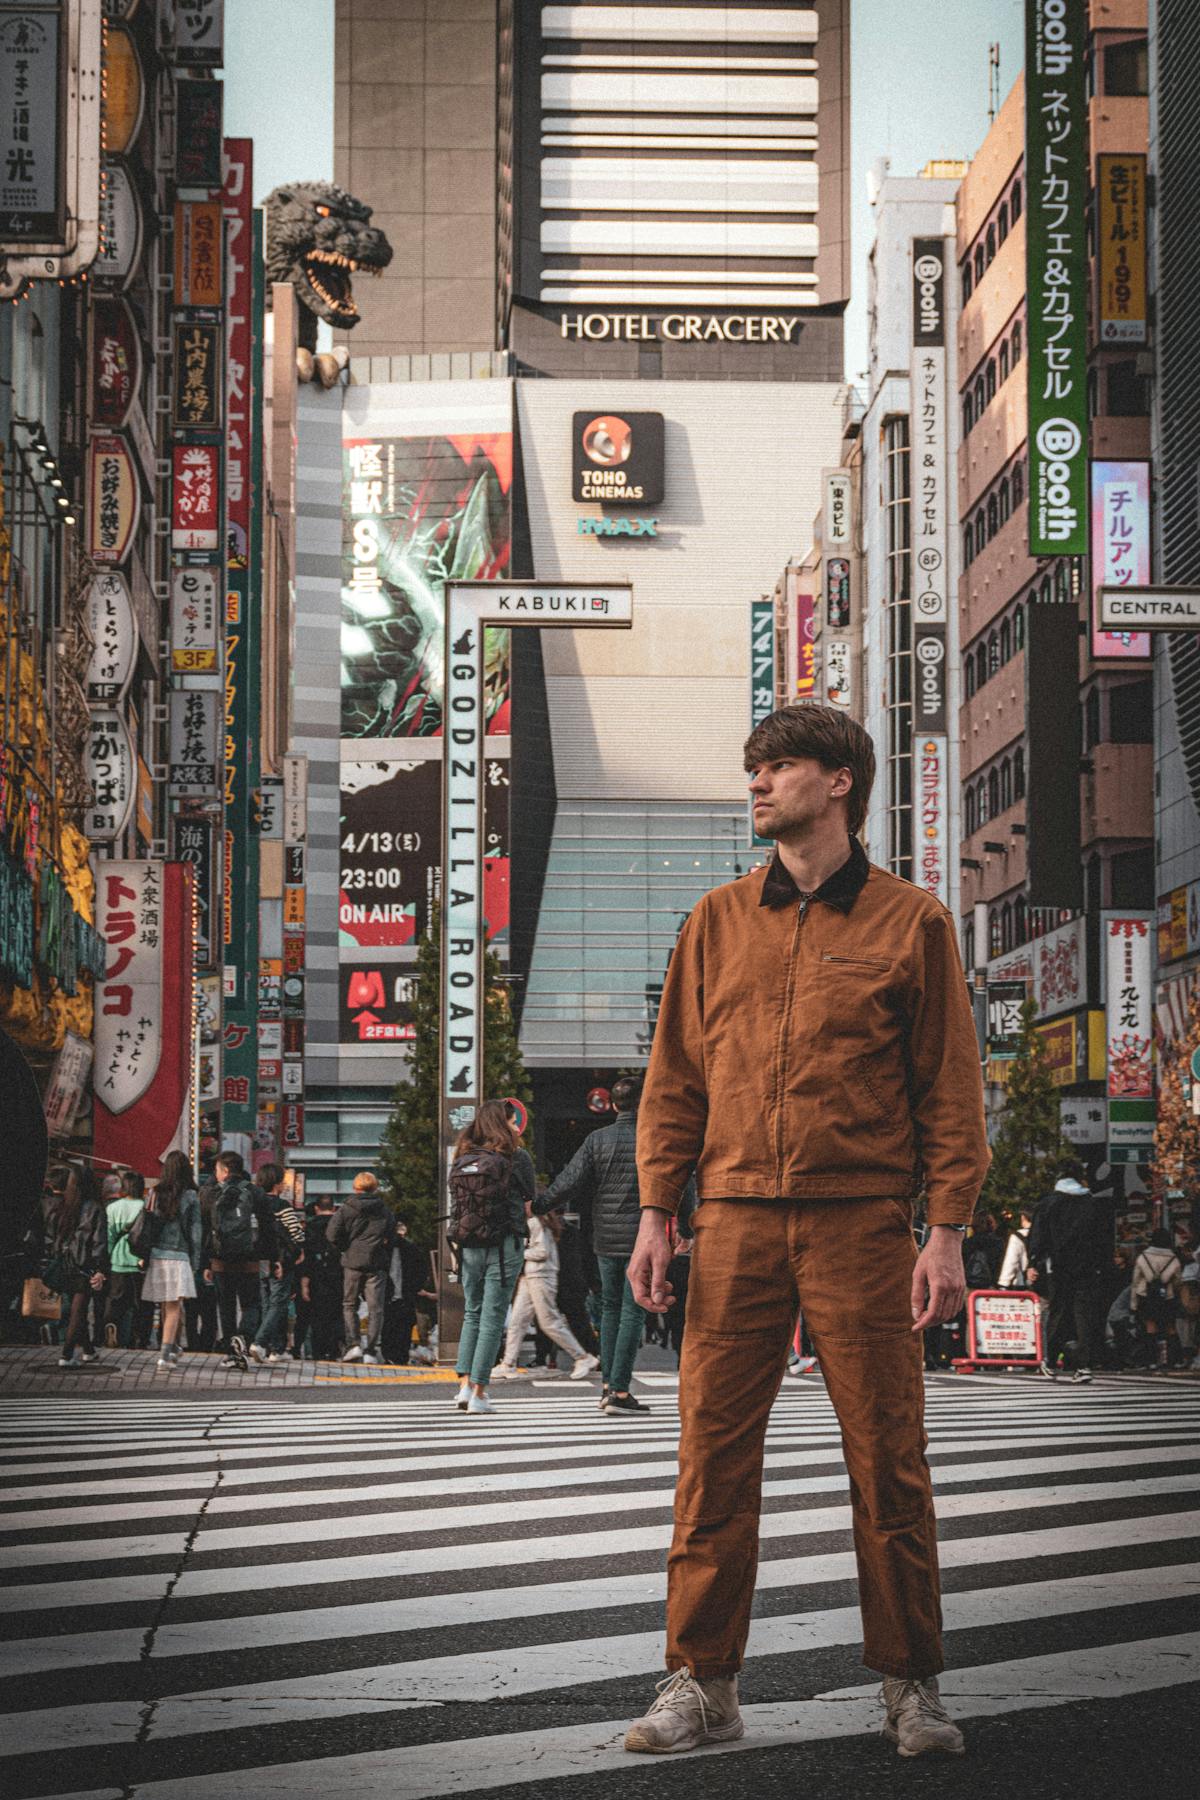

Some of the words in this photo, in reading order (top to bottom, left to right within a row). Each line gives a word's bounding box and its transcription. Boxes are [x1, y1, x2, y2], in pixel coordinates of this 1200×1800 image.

[6, 148, 36, 182] 光
[8, 215, 33, 231] 4F
[914, 254, 943, 333] Booth
[561, 313, 656, 340] HOTEL
[662, 314, 798, 341] GRACERY
[921, 357, 937, 445] ネットカフェ
[922, 453, 936, 467] &
[581, 470, 627, 485] TOHO
[581, 486, 644, 498] CINEMAS
[1036, 417, 1082, 541] Booth
[832, 487, 845, 538] 東京ビル
[921, 476, 938, 536] カプセル
[185, 532, 206, 547] 4F
[577, 517, 658, 536] IMAX
[922, 554, 937, 565] 8F
[922, 599, 937, 609] 5F
[1110, 601, 1197, 615] CENTRAL
[101, 599, 120, 679] とらそば
[183, 652, 207, 667] 3F
[916, 636, 945, 715] Booth
[95, 685, 115, 698] 1F
[90, 735, 120, 806] かっぱ
[451, 664, 476, 908] GODZILLA
[921, 756, 939, 825] カラオケ
[93, 815, 116, 829] B1
[340, 868, 401, 890] 23:00
[140, 867, 160, 949] 大衆酒場
[340, 903, 368, 925] ON
[372, 903, 405, 925] AIR
[103, 876, 137, 1017] トラノコ
[450, 938, 475, 1054] ROAD
[1119, 986, 1140, 1028] 九十九
[989, 1000, 1025, 1034] 怪
[104, 1029, 131, 1090] やきとん
[127, 1017, 153, 1077] やきとり
